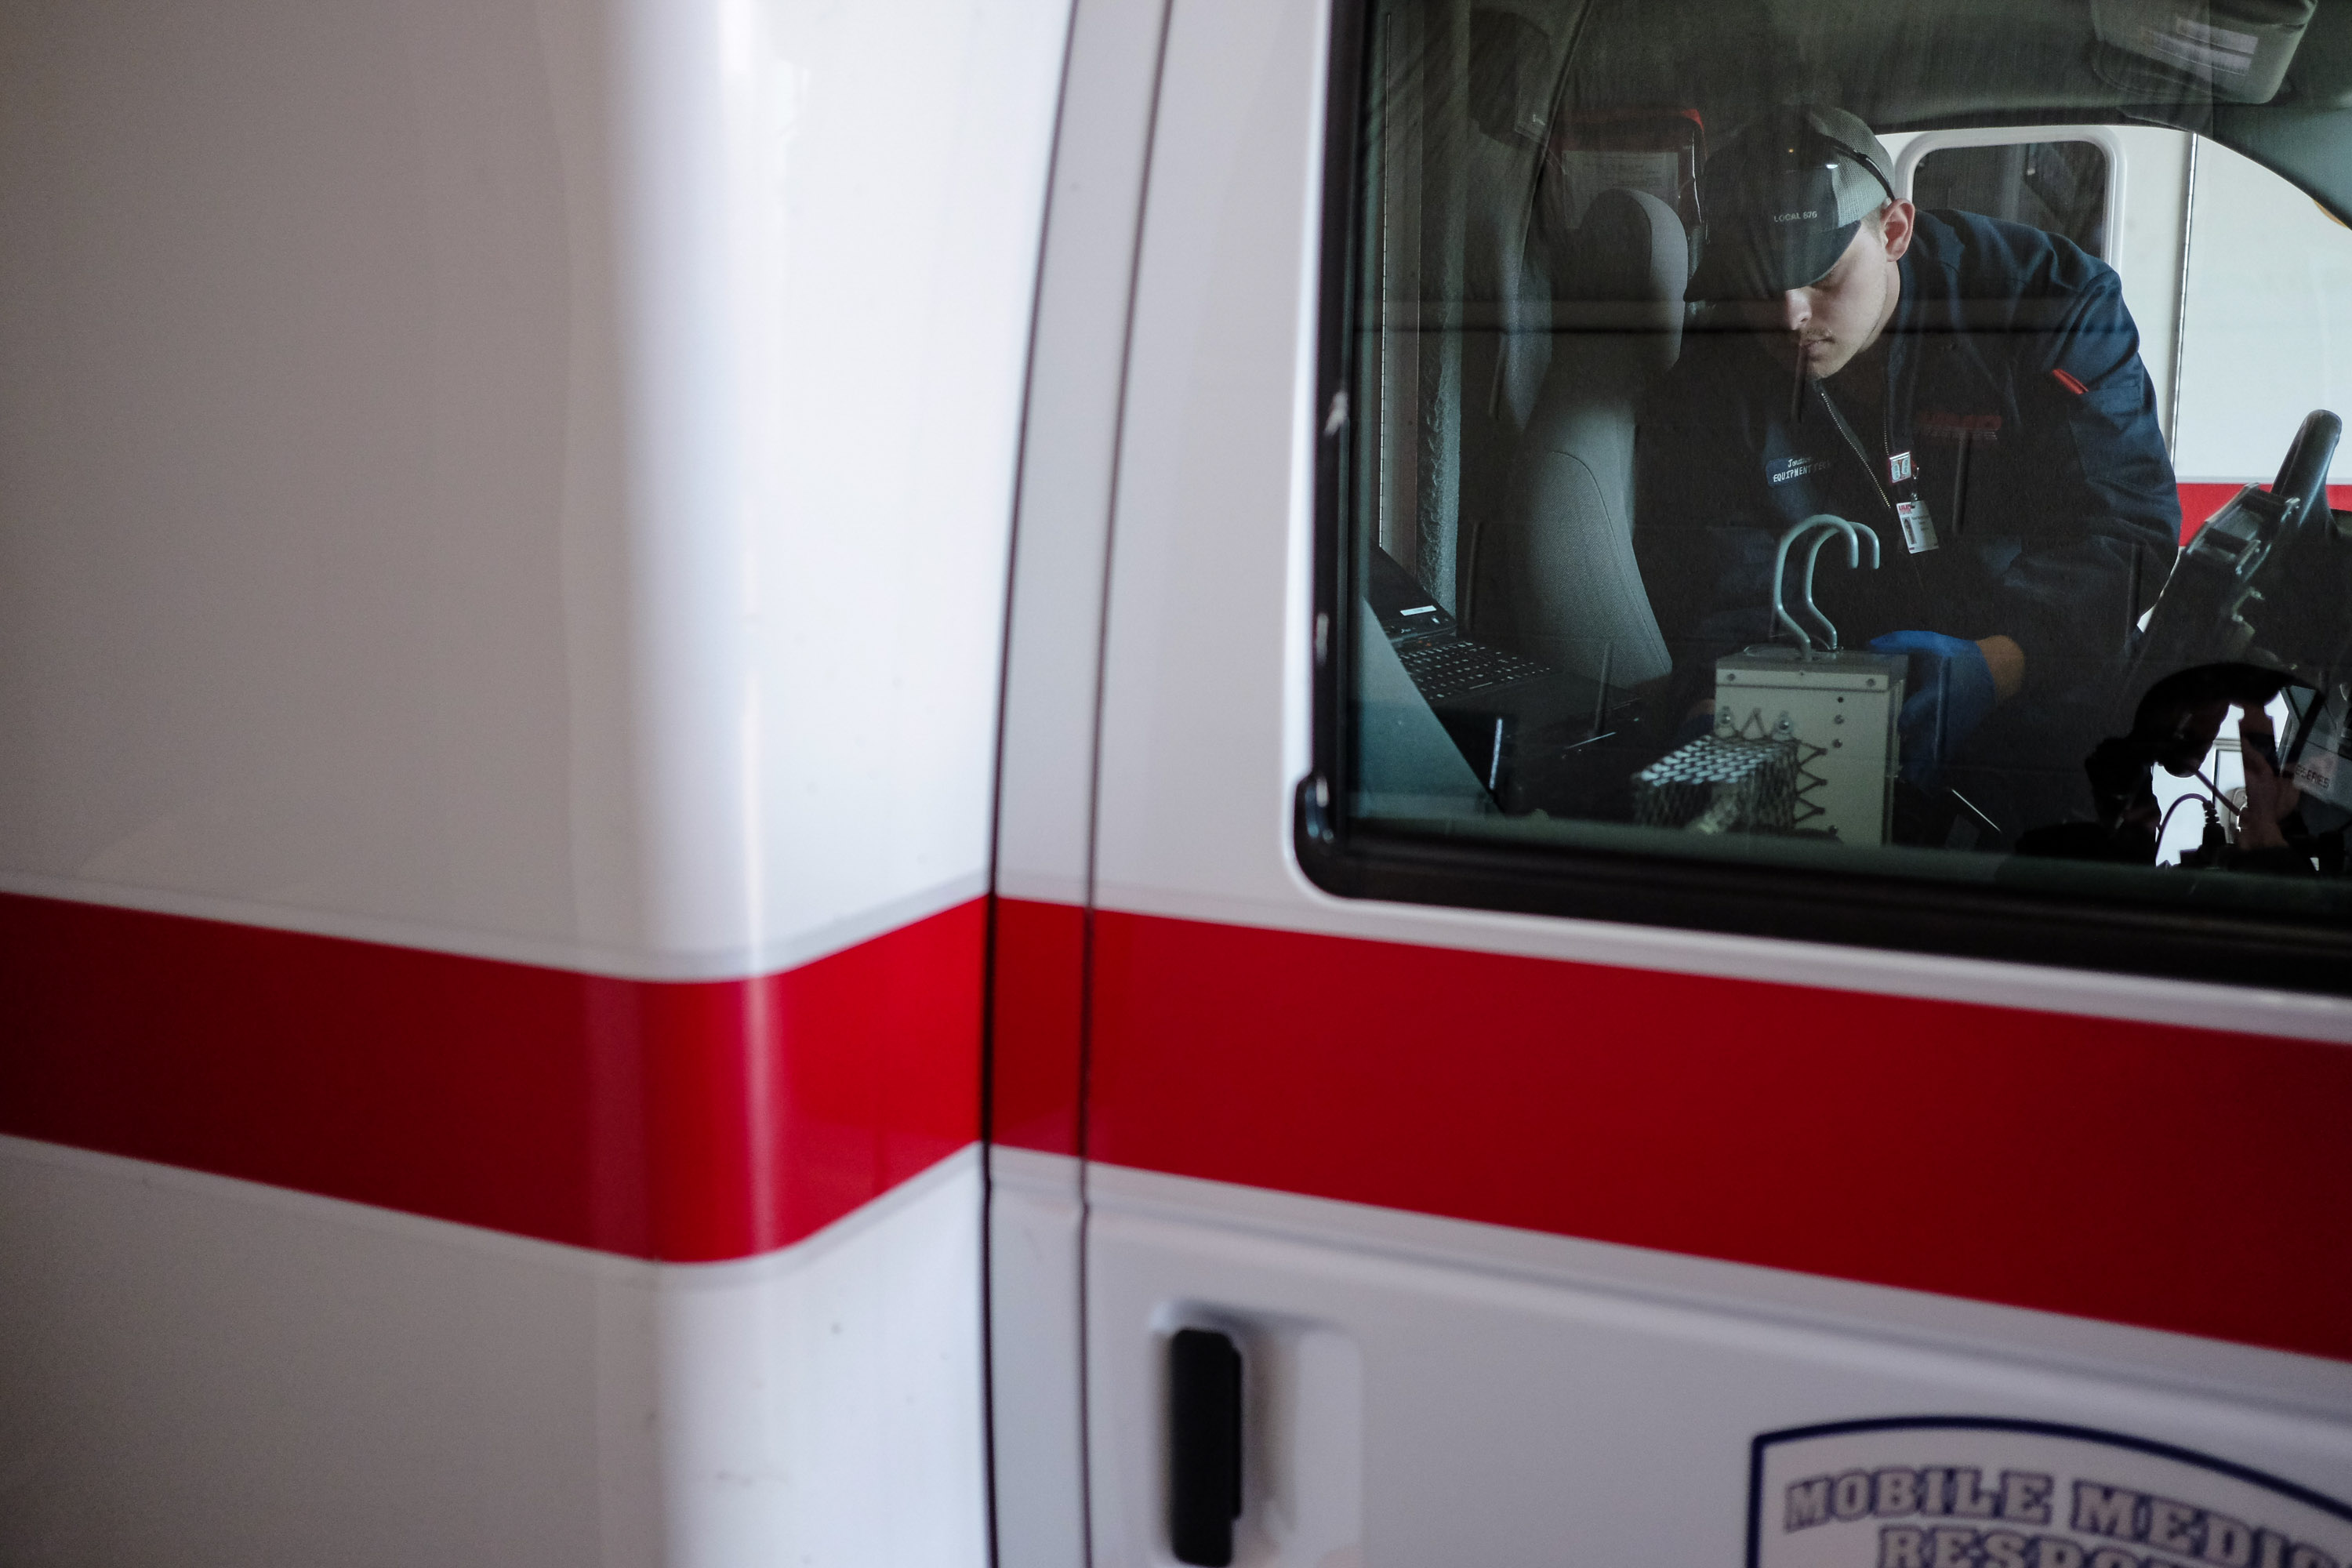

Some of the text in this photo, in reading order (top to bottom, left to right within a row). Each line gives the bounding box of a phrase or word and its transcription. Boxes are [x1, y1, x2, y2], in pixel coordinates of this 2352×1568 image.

[1773, 212, 1801, 223] LOCAL
[1773, 464, 1813, 482] EQUIPMENT
[1784, 1465, 2053, 1533] MOBILE
[1878, 1523, 2189, 1568] RESPO
